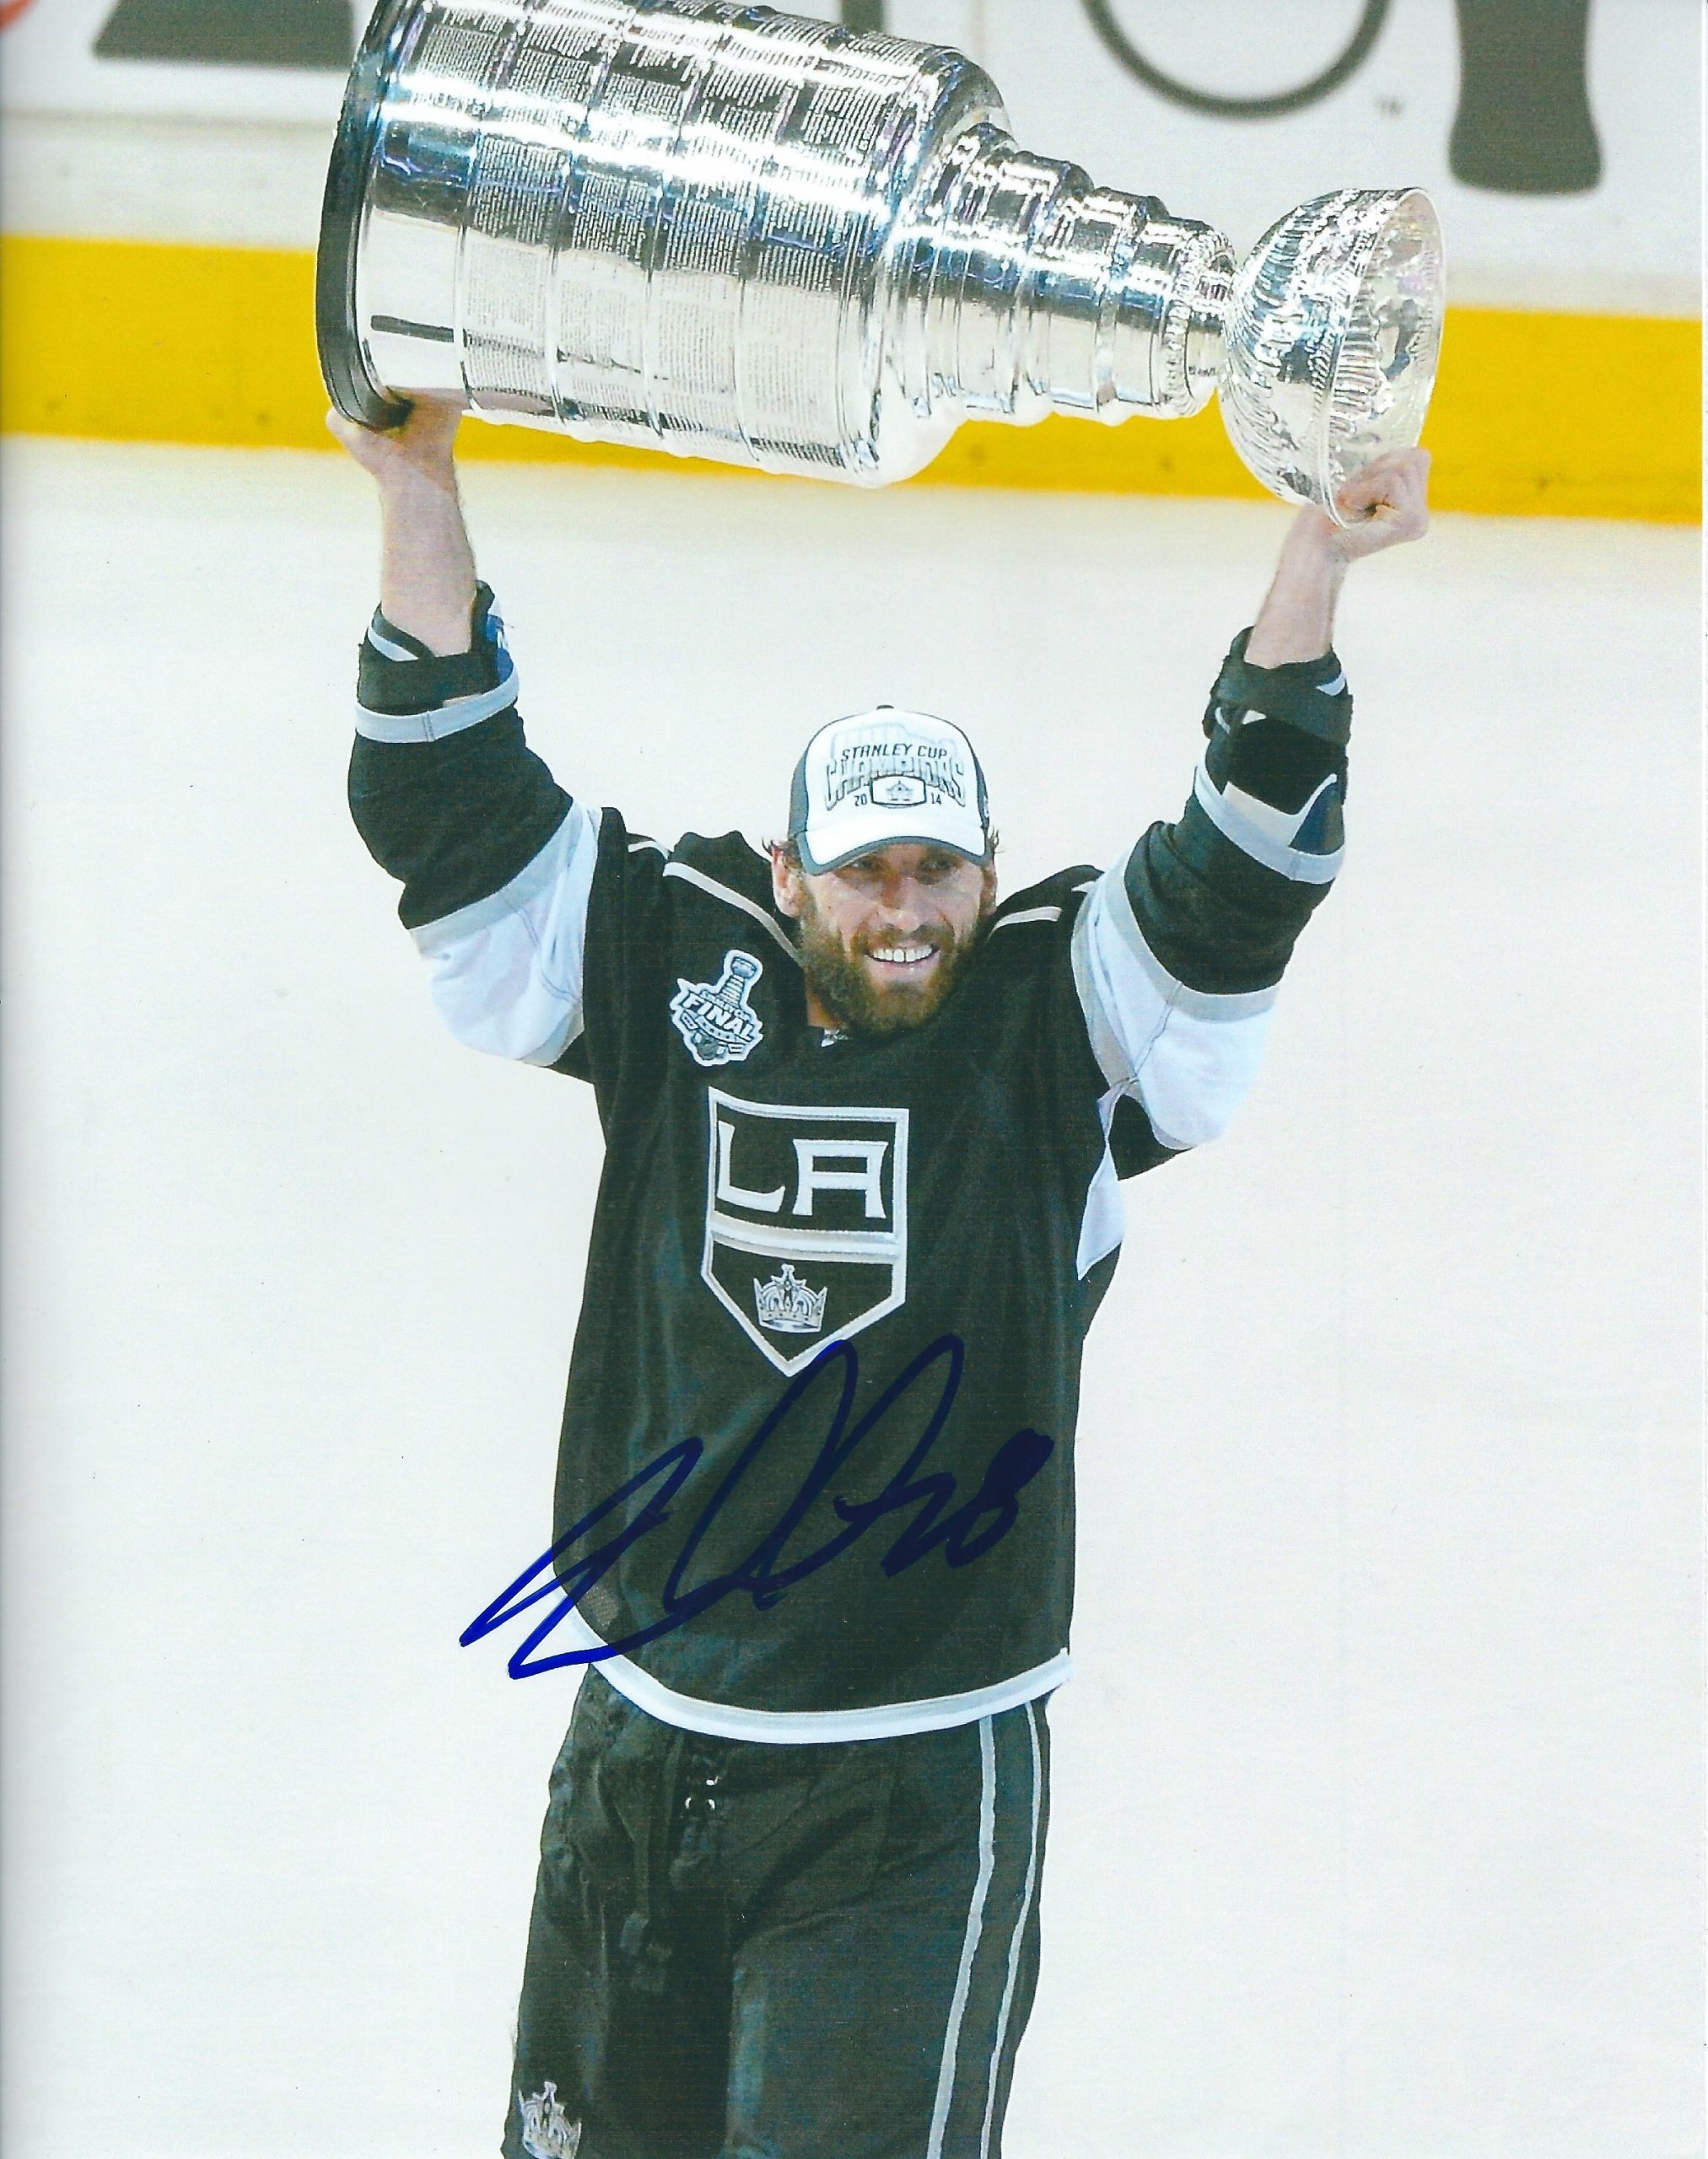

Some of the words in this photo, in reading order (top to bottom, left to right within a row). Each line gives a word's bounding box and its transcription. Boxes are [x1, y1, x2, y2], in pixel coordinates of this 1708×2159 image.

[842, 743, 913, 762] STANLEY
[917, 746, 948, 760] CUP
[825, 756, 967, 810] CHAMPIONS
[854, 794, 868, 806] 20
[930, 793, 942, 807] 14
[681, 991, 755, 1043] FINAL
[717, 1120, 890, 1219] LA
